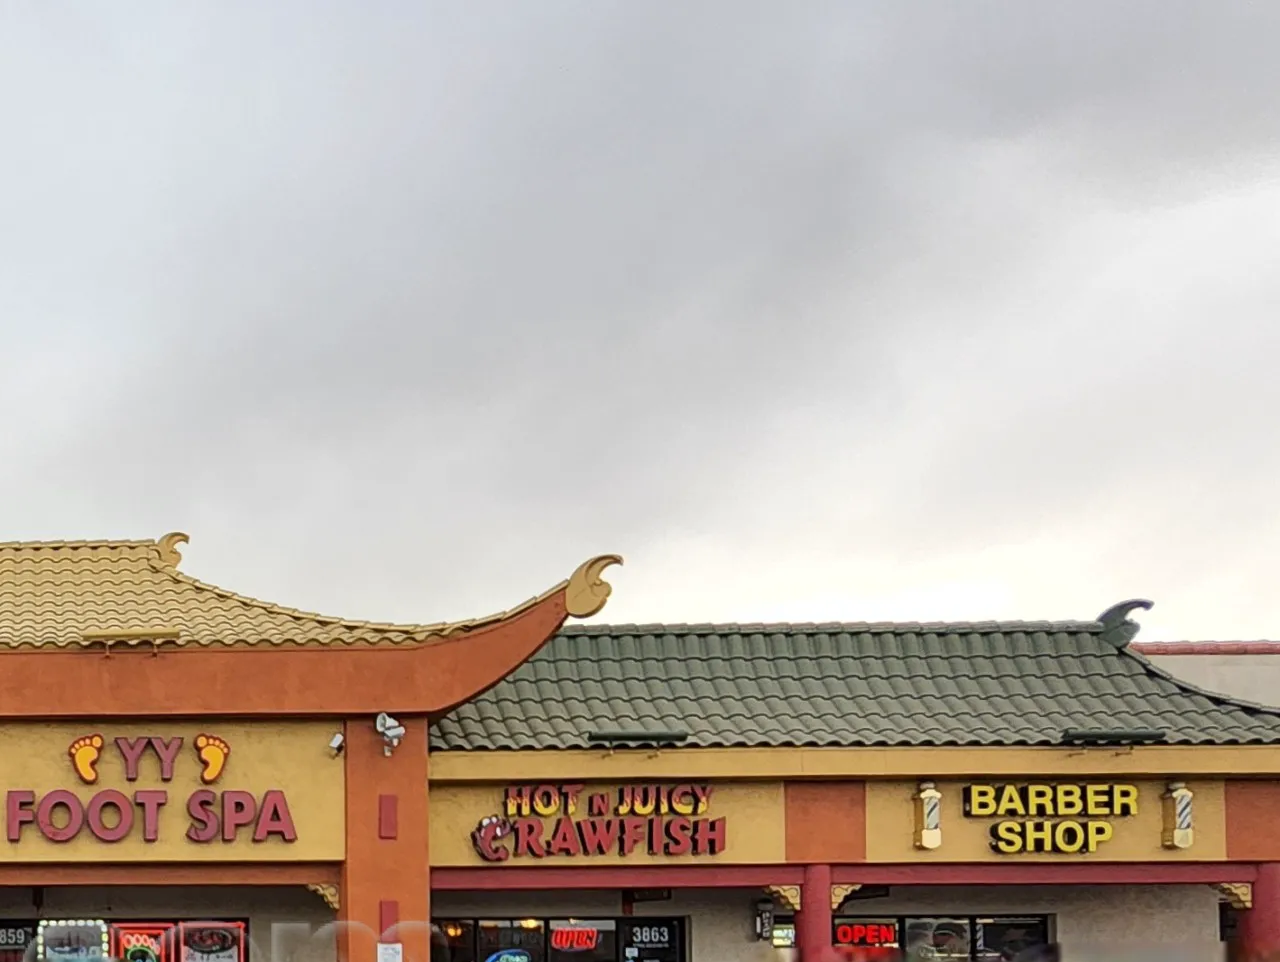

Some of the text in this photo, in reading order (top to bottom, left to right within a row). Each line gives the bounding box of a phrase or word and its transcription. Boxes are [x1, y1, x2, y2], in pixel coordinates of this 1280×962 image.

[114, 736, 184, 782] YY
[6, 789, 298, 843] FOOT SPA
[505, 783, 585, 816] HOT
[614, 783, 714, 817] JUICY
[964, 784, 1139, 818] BARBER
[471, 814, 727, 862] CRAWFISH
[992, 820, 1113, 854] SHOP
[632, 926, 669, 942] 3863
[836, 924, 896, 944] OPEN
